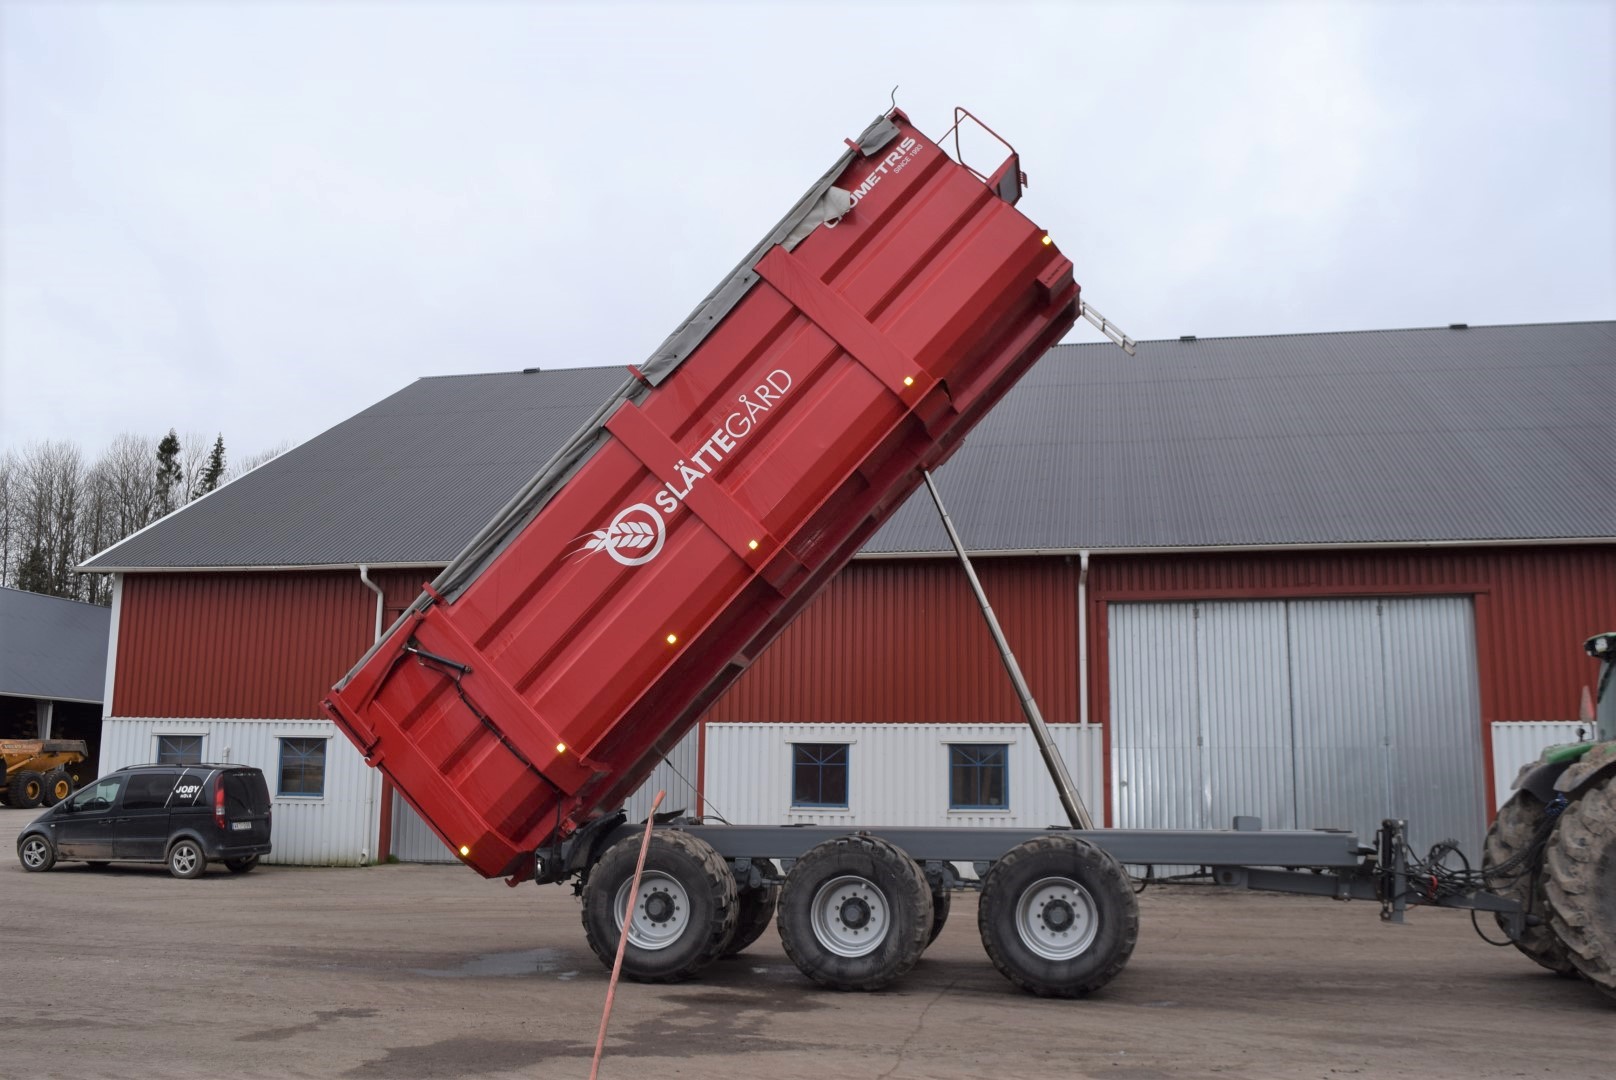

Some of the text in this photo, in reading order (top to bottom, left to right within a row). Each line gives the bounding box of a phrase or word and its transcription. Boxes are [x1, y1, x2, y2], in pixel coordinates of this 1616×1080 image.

[823, 136, 916, 229] UMETRIS
[893, 156, 911, 174] SINCE
[655, 369, 792, 513] SLÄTTEGÅRD
[175, 785, 200, 793] JOBY
